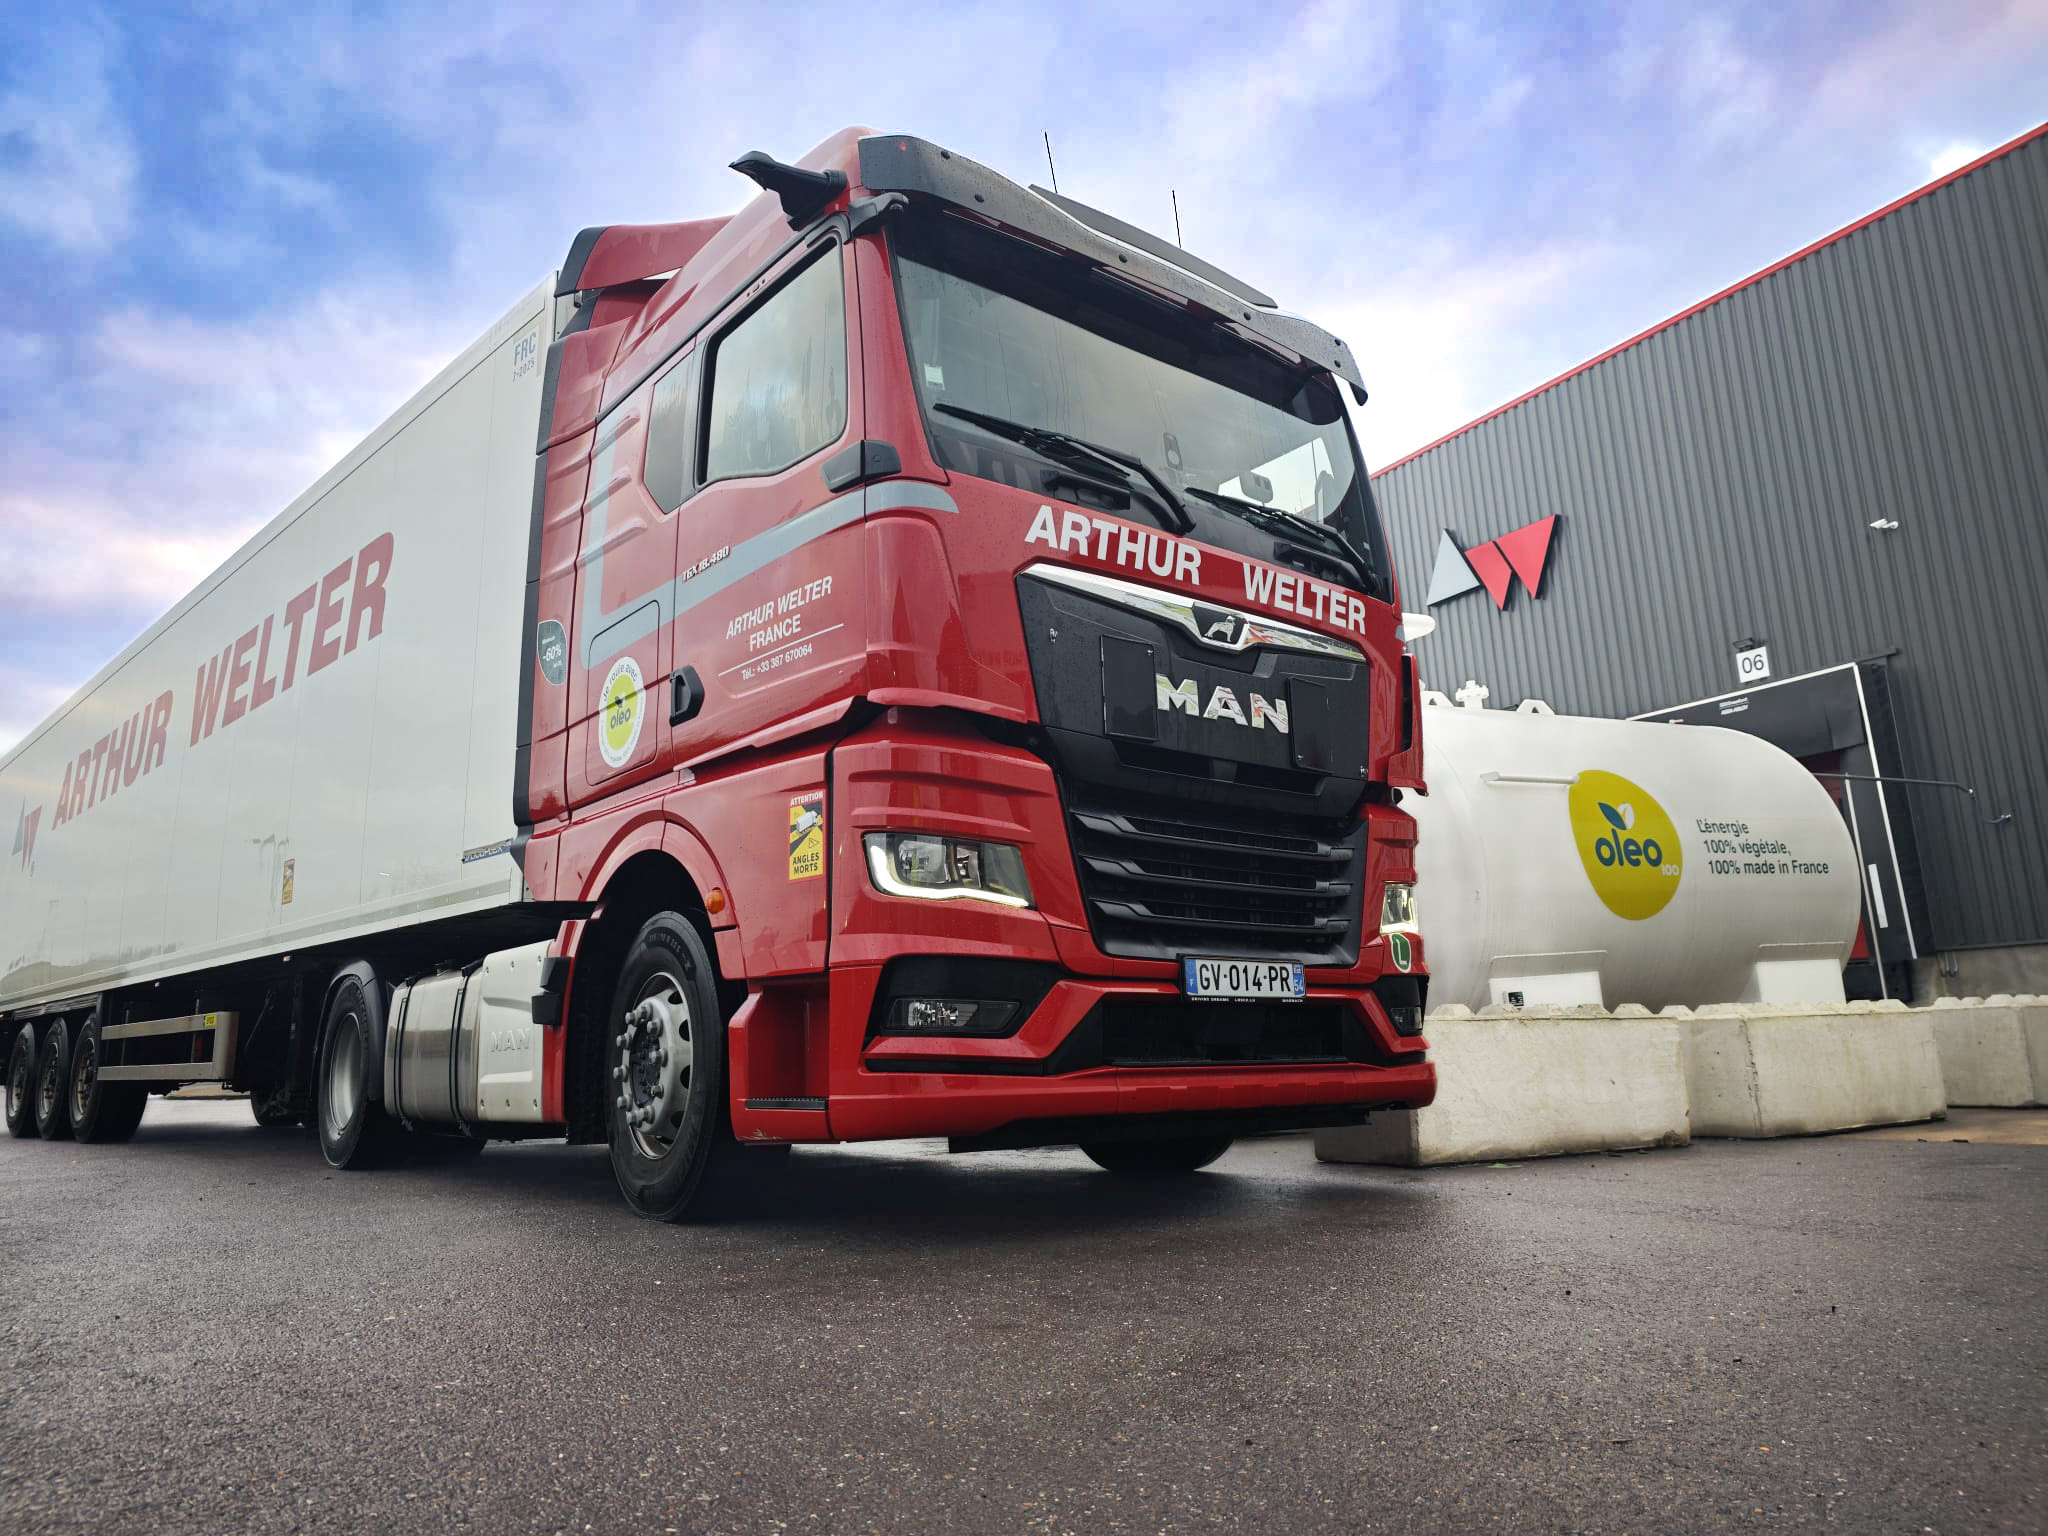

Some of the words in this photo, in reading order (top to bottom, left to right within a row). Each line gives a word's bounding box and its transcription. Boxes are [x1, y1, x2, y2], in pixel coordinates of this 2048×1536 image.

[513, 331, 537, 367] FRC
[1024, 504, 1202, 586] ARTHUR
[1242, 561, 1367, 636] WELTER
[726, 601, 775, 640] ARTHUR
[777, 575, 832, 616] WELTER
[749, 613, 801, 652] FRANCE
[785, 643, 813, 663] 670064
[1742, 654, 1765, 674] 06
[51, 690, 174, 831] ARTHUR
[189, 532, 394, 748] WELTER
[1156, 673, 1289, 734] MAN
[610, 707, 632, 730] oleo
[790, 791, 824, 807] ATTENTION
[792, 852, 820, 866] ANGLES
[1595, 828, 1663, 867] oleo
[1661, 864, 1680, 877] 100
[1703, 839, 1737, 855] 100%
[1738, 838, 1792, 858] végétale,
[794, 862, 819, 875] MORTS
[1708, 860, 1741, 875] 100%
[1743, 860, 1776, 875] made
[1778, 860, 1790, 875] in
[1791, 860, 1830, 875] France
[490, 1027, 529, 1053] MAN
